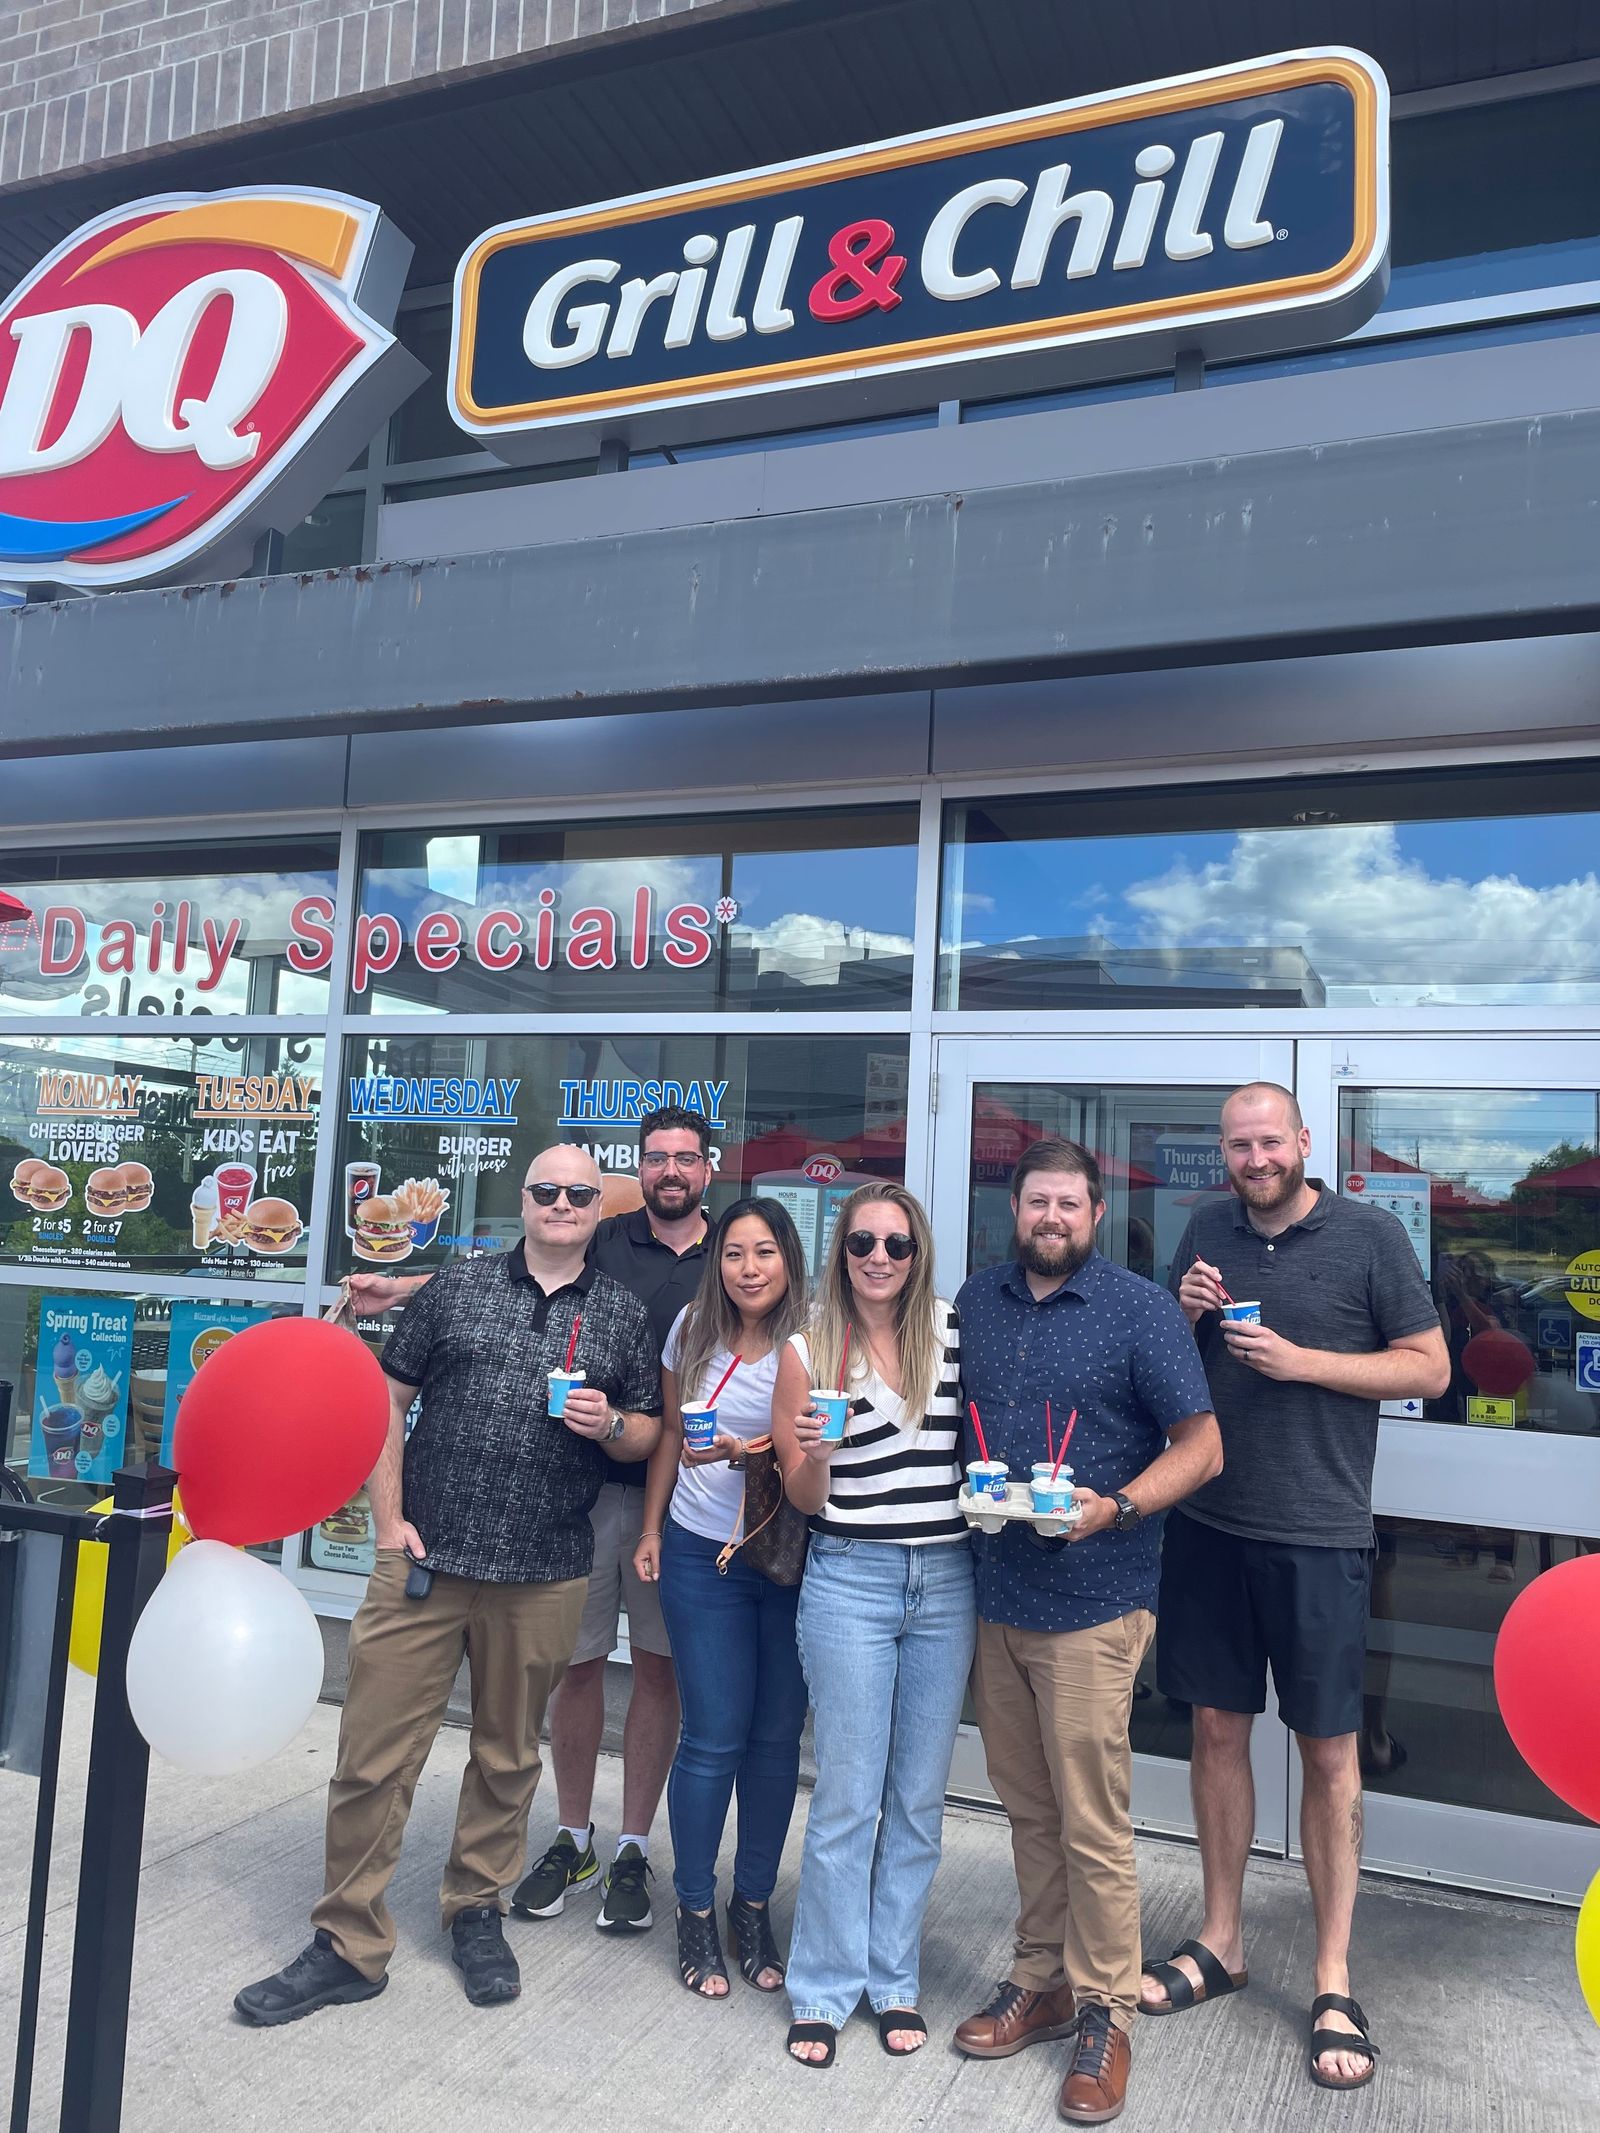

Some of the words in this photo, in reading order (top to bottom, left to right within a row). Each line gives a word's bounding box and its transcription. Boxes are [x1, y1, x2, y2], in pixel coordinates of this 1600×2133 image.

[523, 215, 804, 369] Grill
[808, 218, 907, 323] &
[0, 269, 262, 471] DQ
[39, 900, 242, 992] Daily
[39, 1073, 143, 1108] MONDAY
[195, 1076, 317, 1111] TUESDAY
[350, 1077, 521, 1115] WEDNESDAY
[560, 1080, 729, 1119] THURSDAY
[29, 1122, 145, 1141] CHEESEBURGER
[203, 1129, 255, 1152] KIDS
[258, 1130, 300, 1154] EAT
[438, 1136, 512, 1156] BURGER
[48, 1140, 120, 1162] LOVERS
[1163, 1149, 1226, 1166] Thursda
[438, 1154, 467, 1179] with
[469, 1153, 508, 1176] cheese
[810, 1164, 836, 1180] DQ
[1169, 1167, 1204, 1188] Aug.
[1208, 1168, 1224, 1185] 11
[226, 1197, 241, 1206] DQ
[32, 1217, 42, 1232] 2
[43, 1218, 56, 1230] for
[58, 1219, 72, 1233] $5
[82, 1220, 92, 1235] 2
[94, 1221, 107, 1233] for
[108, 1221, 122, 1236] $7
[86, 1235, 116, 1243] DOUBLES
[32, 1246, 67, 1255] Cheeseburger
[231, 1269, 245, 1278] store
[46, 1310, 88, 1334] Spring
[92, 1312, 127, 1331] Treat
[194, 1313, 216, 1321] Blizzard
[357, 1320, 381, 1332] cials
[91, 1332, 126, 1342] Collection
[82, 1424, 98, 1435] DQ
[56, 1450, 71, 1460] DQ
[983, 1484, 1005, 1492] BLIZZ
[342, 1552, 358, 1560] Deluxe
